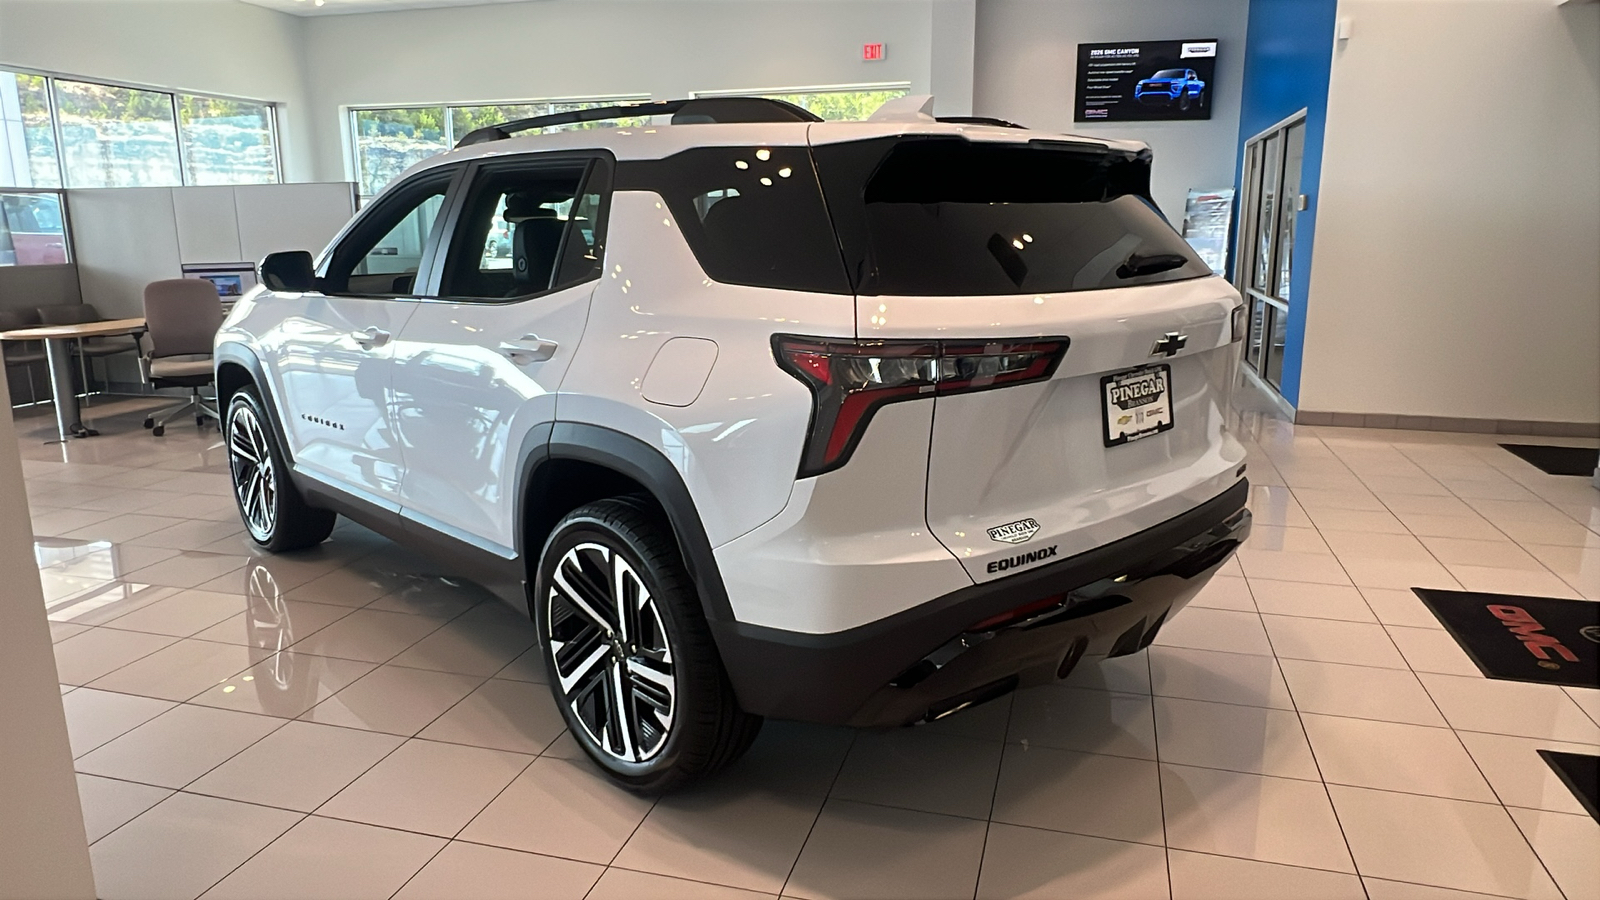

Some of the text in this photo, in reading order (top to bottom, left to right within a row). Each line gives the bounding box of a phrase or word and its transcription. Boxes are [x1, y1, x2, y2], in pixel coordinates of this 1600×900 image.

[864, 44, 882, 59] EXIT
[1111, 377, 1164, 404] PINEGAR
[990, 520, 1038, 539] PINEGAR
[986, 544, 1058, 574] EQUINOX
[1486, 604, 1580, 663] GMC
